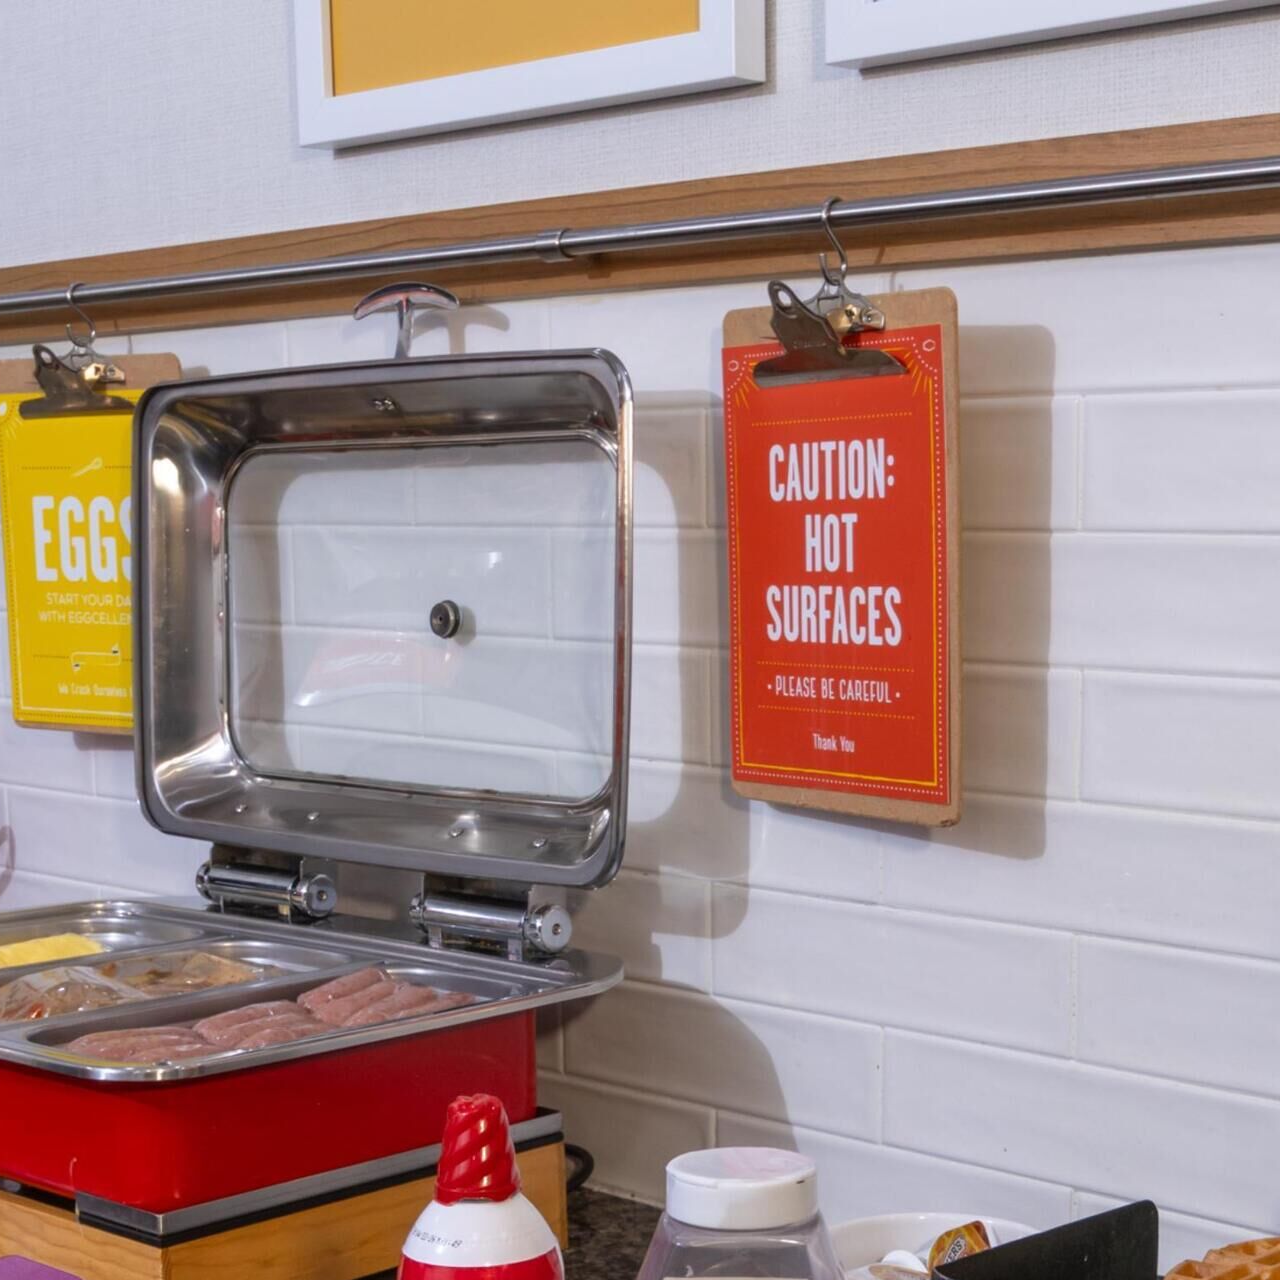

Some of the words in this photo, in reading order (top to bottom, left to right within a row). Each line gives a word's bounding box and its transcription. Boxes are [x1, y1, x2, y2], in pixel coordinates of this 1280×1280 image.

[769, 438, 894, 502] CAUTION:
[805, 514, 858, 573] HOT
[46, 592, 80, 606] START
[81, 593, 113, 607] YOUR
[39, 610, 66, 622] WITH
[766, 586, 902, 647] SURFACES
[775, 680, 817, 700] PLEASE
[821, 682, 835, 700] BE
[839, 682, 893, 704] CAREFUL
[813, 732, 836, 752] Thank
[839, 734, 855, 753] You
